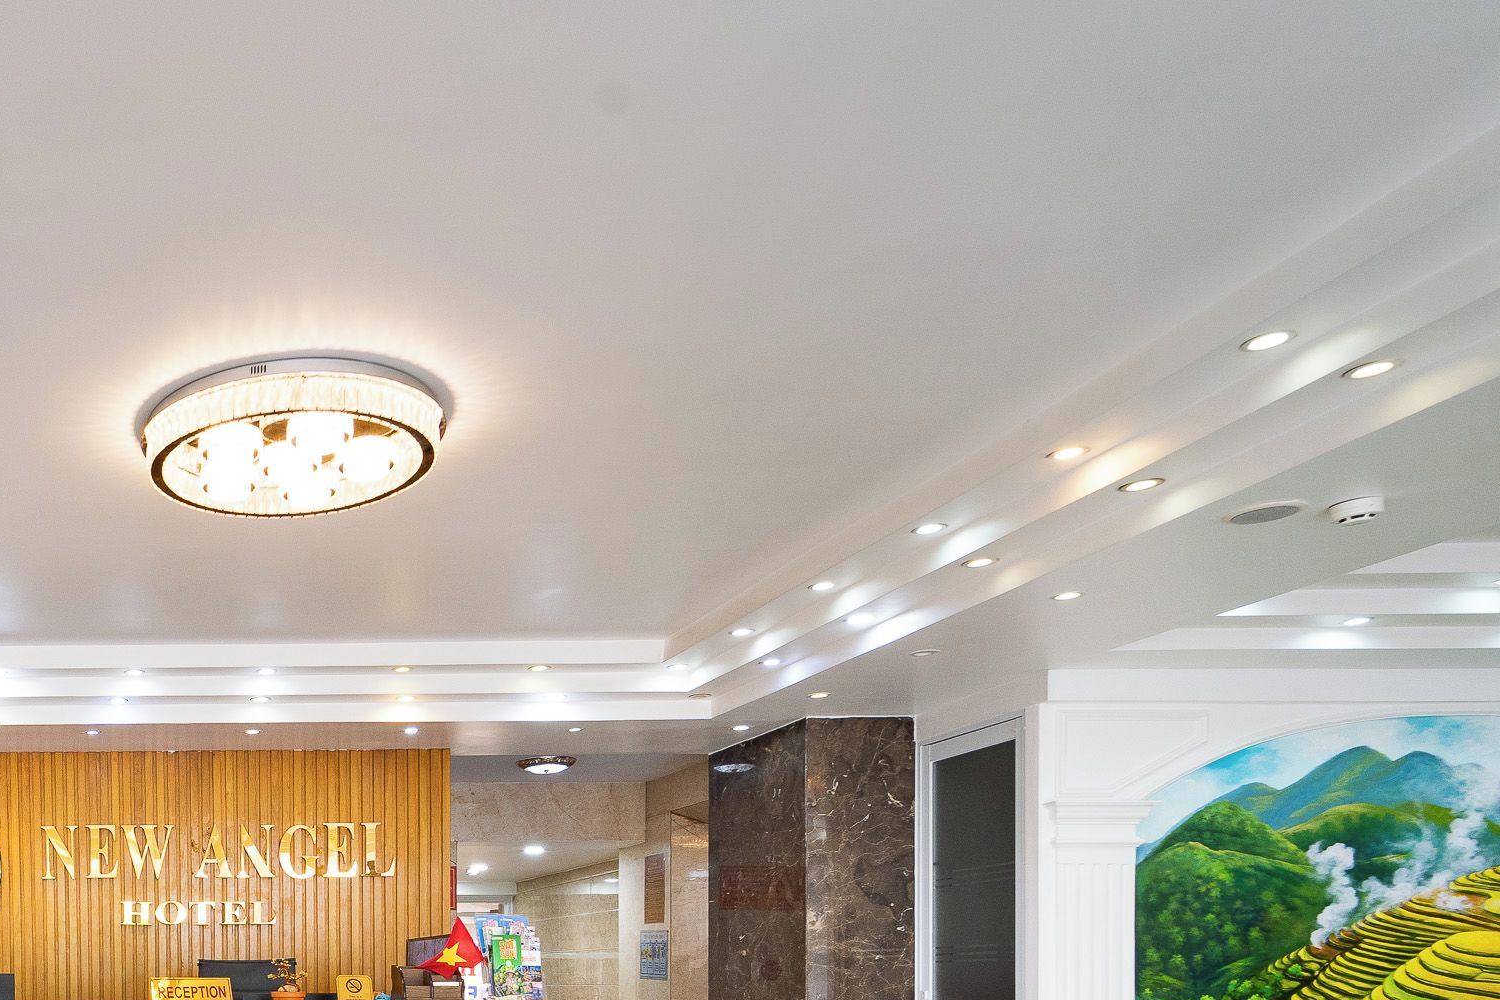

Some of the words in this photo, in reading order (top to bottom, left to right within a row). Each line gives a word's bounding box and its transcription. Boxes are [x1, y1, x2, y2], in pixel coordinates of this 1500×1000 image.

[41, 824, 174, 880] NEW
[194, 822, 396, 880] ANGEL
[120, 901, 277, 926] HOTEL
[156, 985, 228, 999] RECEPTION
